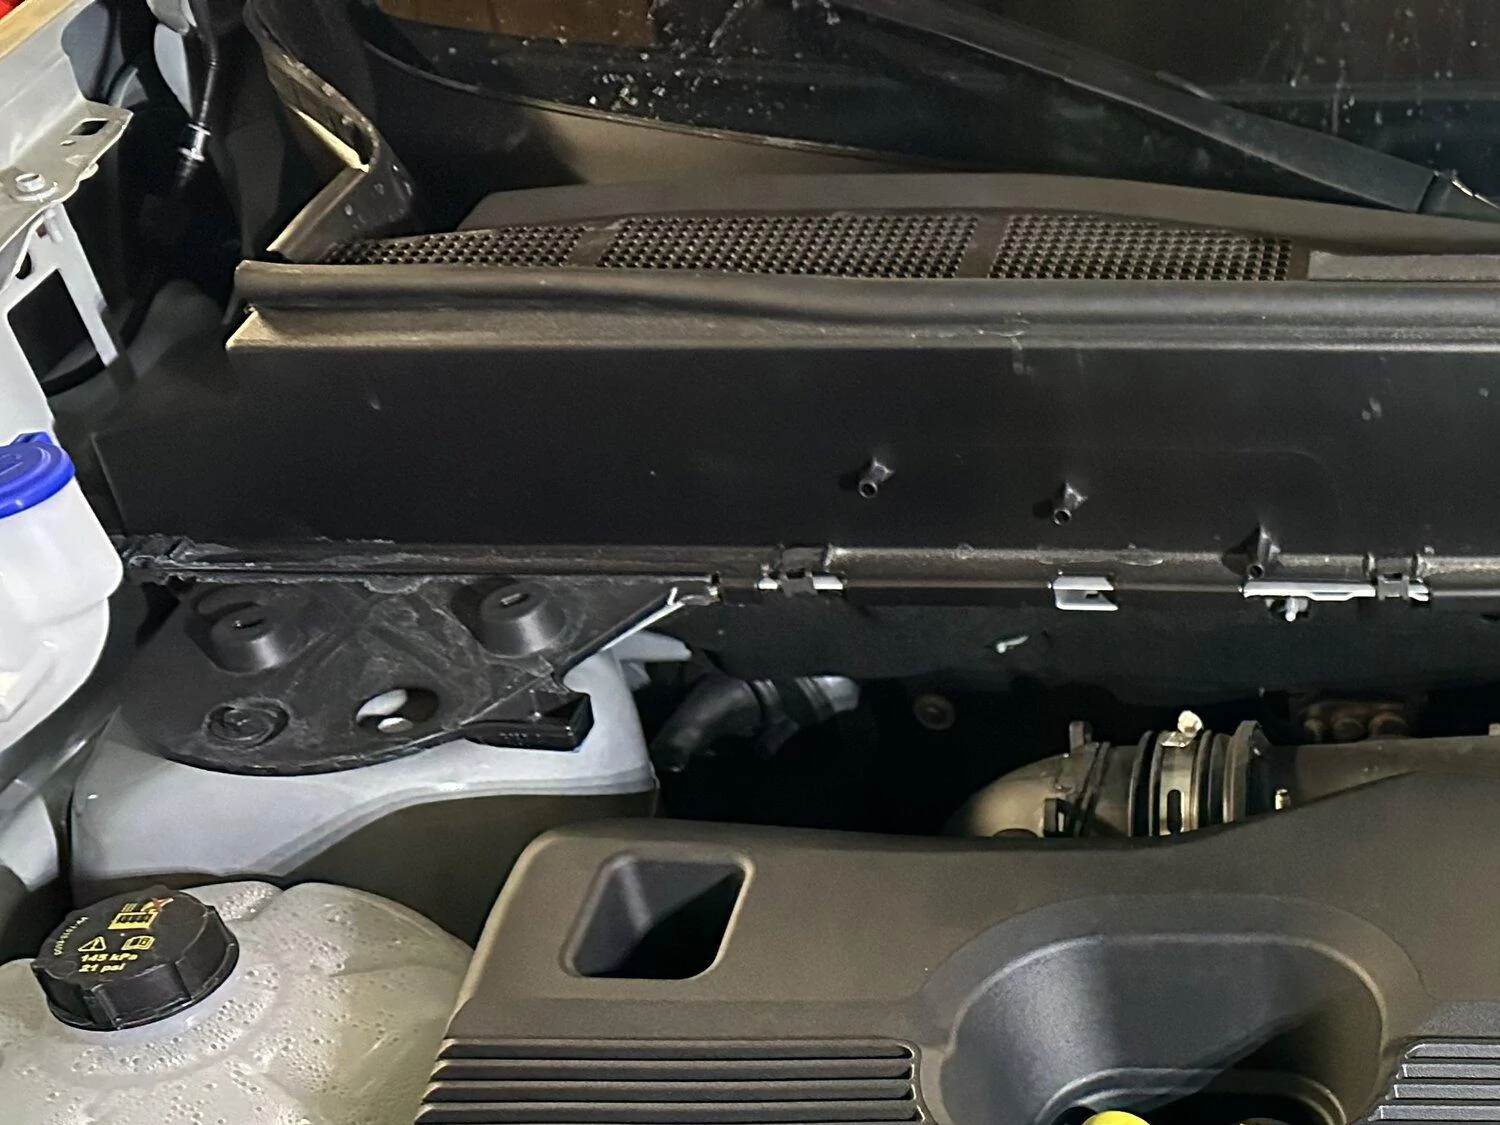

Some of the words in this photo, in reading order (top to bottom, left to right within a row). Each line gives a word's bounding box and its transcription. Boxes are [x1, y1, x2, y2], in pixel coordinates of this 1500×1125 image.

[81, 953, 108, 962] 145
[109, 952, 138, 961] kPa
[78, 964, 99, 973] 21
[100, 962, 126, 973] psi
